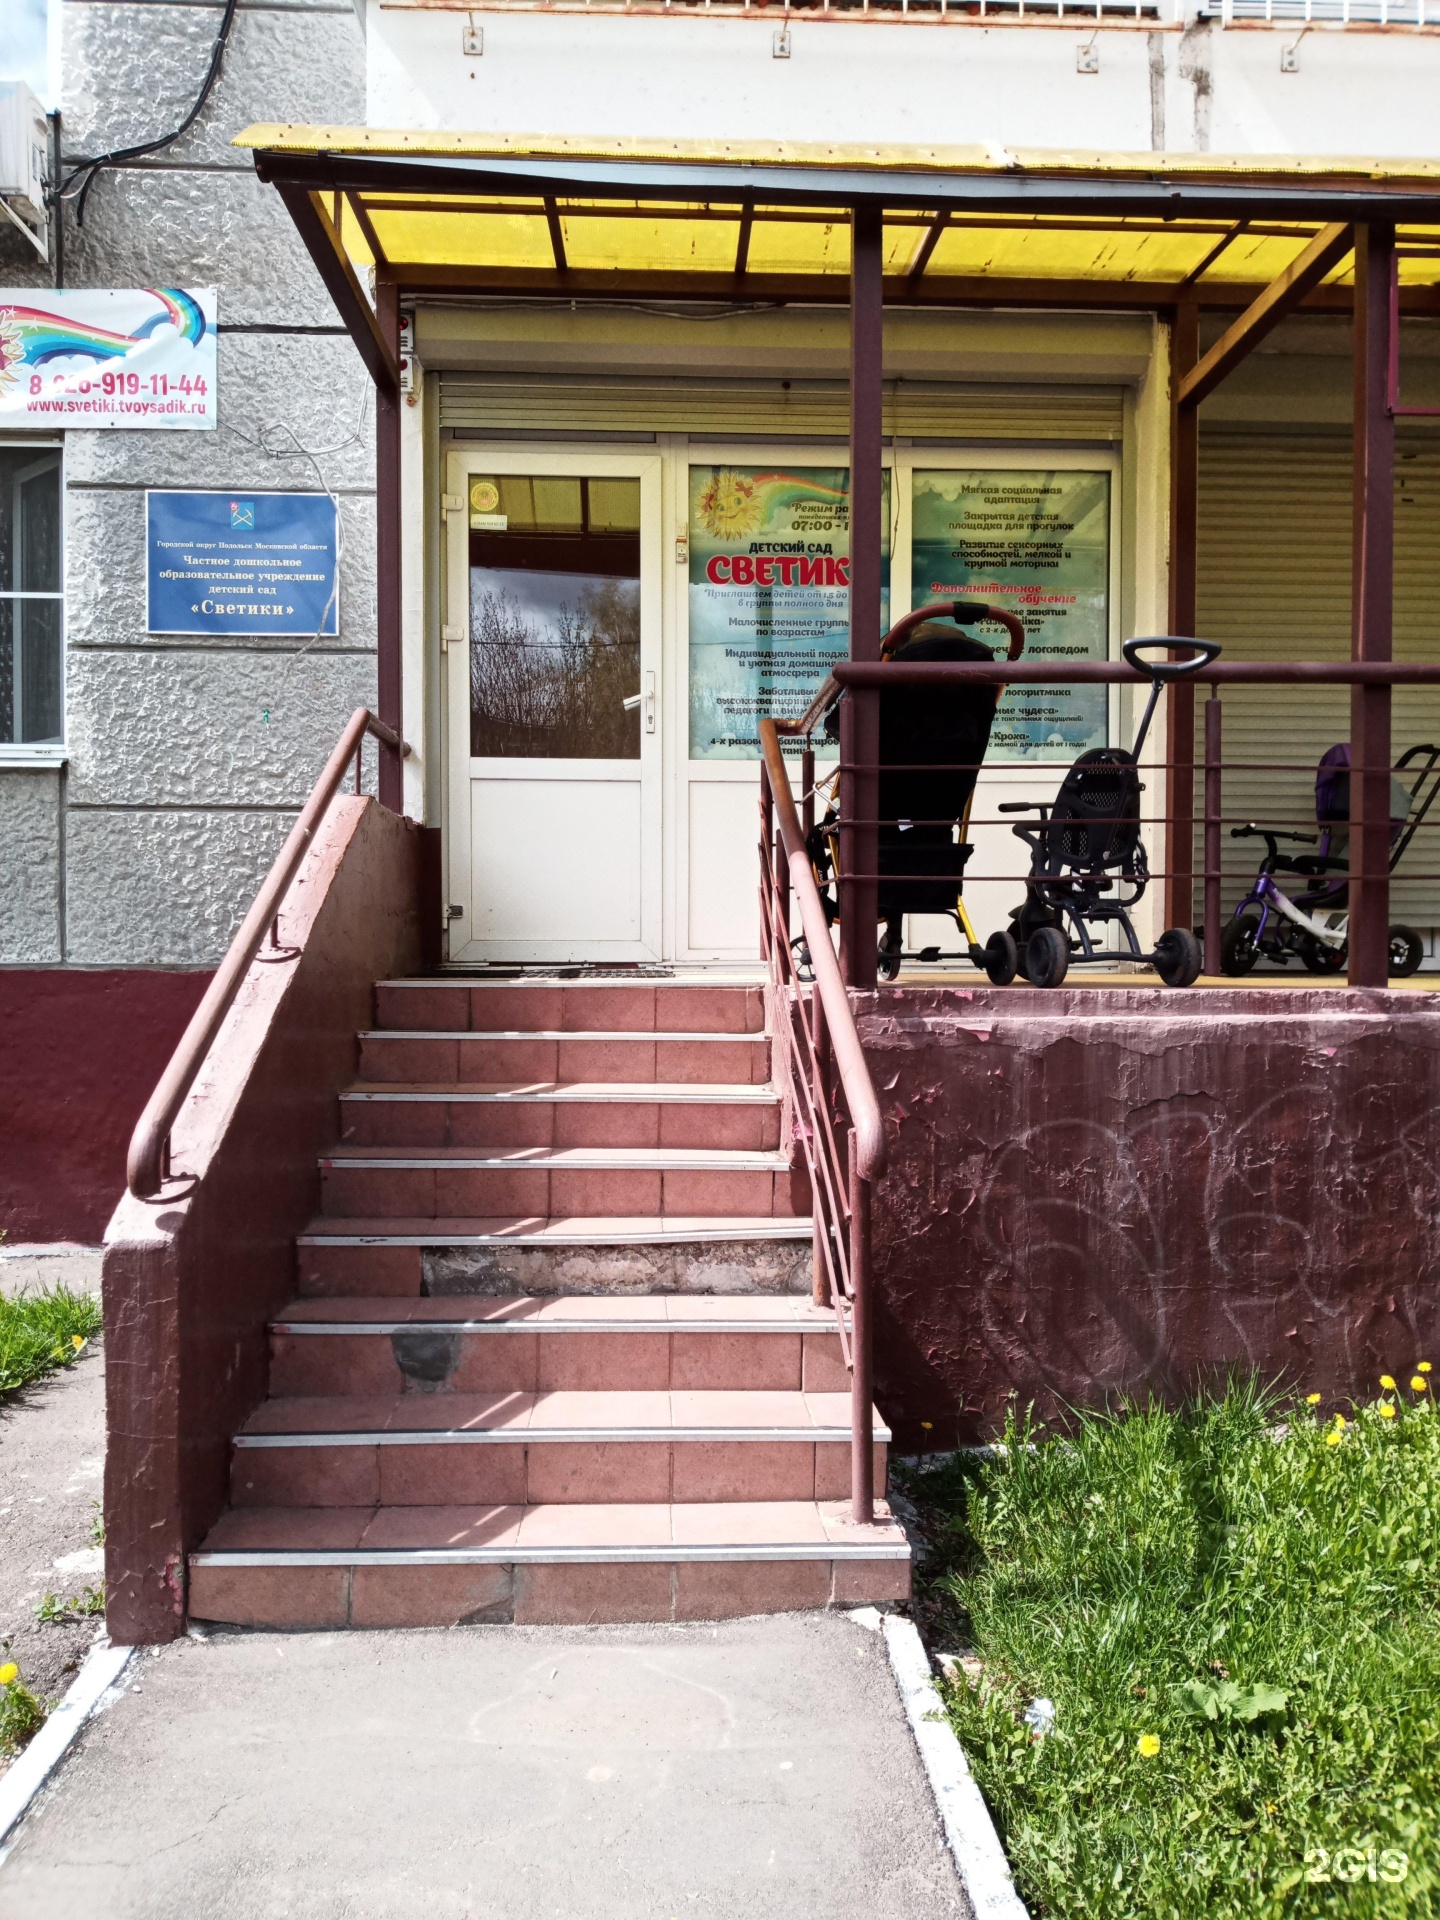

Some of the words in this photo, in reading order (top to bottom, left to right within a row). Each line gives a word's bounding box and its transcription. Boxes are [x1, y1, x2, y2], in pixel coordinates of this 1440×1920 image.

[27, 399, 206, 416] www.svetiki.tvoysadik.ru
[961, 485, 1000, 496] Мягкая
[1002, 486, 1062, 496] социальная
[984, 496, 1040, 505] адаптация
[792, 502, 833, 513] Режим
[964, 512, 1015, 522] Закрытая
[1017, 512, 1058, 522] детская
[791, 520, 832, 532] 07:00
[948, 522, 1003, 532] площадка
[1005, 522, 1024, 532] для
[1026, 522, 1074, 532] прогулок
[157, 540, 194, 548] Городской
[196, 542, 216, 550] округ
[218, 542, 253, 550] Подольск
[255, 542, 298, 550] Московской
[299, 543, 328, 551] области
[749, 540, 805, 554] ДЕТСКИЙ
[808, 542, 833, 555] САД
[959, 540, 1006, 550] Развитие
[1008, 541, 1064, 551] сенсорных
[1024, 550, 1062, 559] мелкой
[183, 555, 230, 567] Частное
[233, 556, 302, 568] дошкольное
[964, 558, 1008, 570] крупной
[1010, 560, 1059, 570] моторики
[159, 569, 254, 580] образовательное
[258, 572, 326, 582] учреждение
[706, 555, 850, 587] СВЕТИК
[208, 584, 254, 595] детский
[257, 586, 277, 596] сад
[931, 582, 1042, 594] Дополнительное
[704, 589, 772, 600] Приглашаем
[773, 589, 805, 599] детей
[807, 590, 822, 599] от
[836, 590, 848, 600] до
[1018, 594, 1077, 605] обучение
[191, 599, 295, 616] «Светики»
[746, 600, 783, 609] группы
[784, 600, 824, 608] полного
[826, 599, 844, 608] дня
[1026, 608, 1067, 616] занятия
[728, 616, 813, 627] Малочисленные
[756, 628, 769, 636] по
[770, 629, 825, 638] возрастам
[725, 648, 816, 659] Индивидуальный
[818, 650, 849, 660] подхо
[1028, 645, 1089, 655] логопедом
[738, 660, 746, 668] и
[748, 660, 786, 670] уютная
[788, 660, 836, 670] домашня
[761, 668, 820, 679] атмосфера
[1005, 688, 1072, 697] логоритмика
[724, 706, 770, 716] педагоги
[1018, 707, 1059, 717] чудеса»
[990, 732, 1030, 742] «Кроха»
